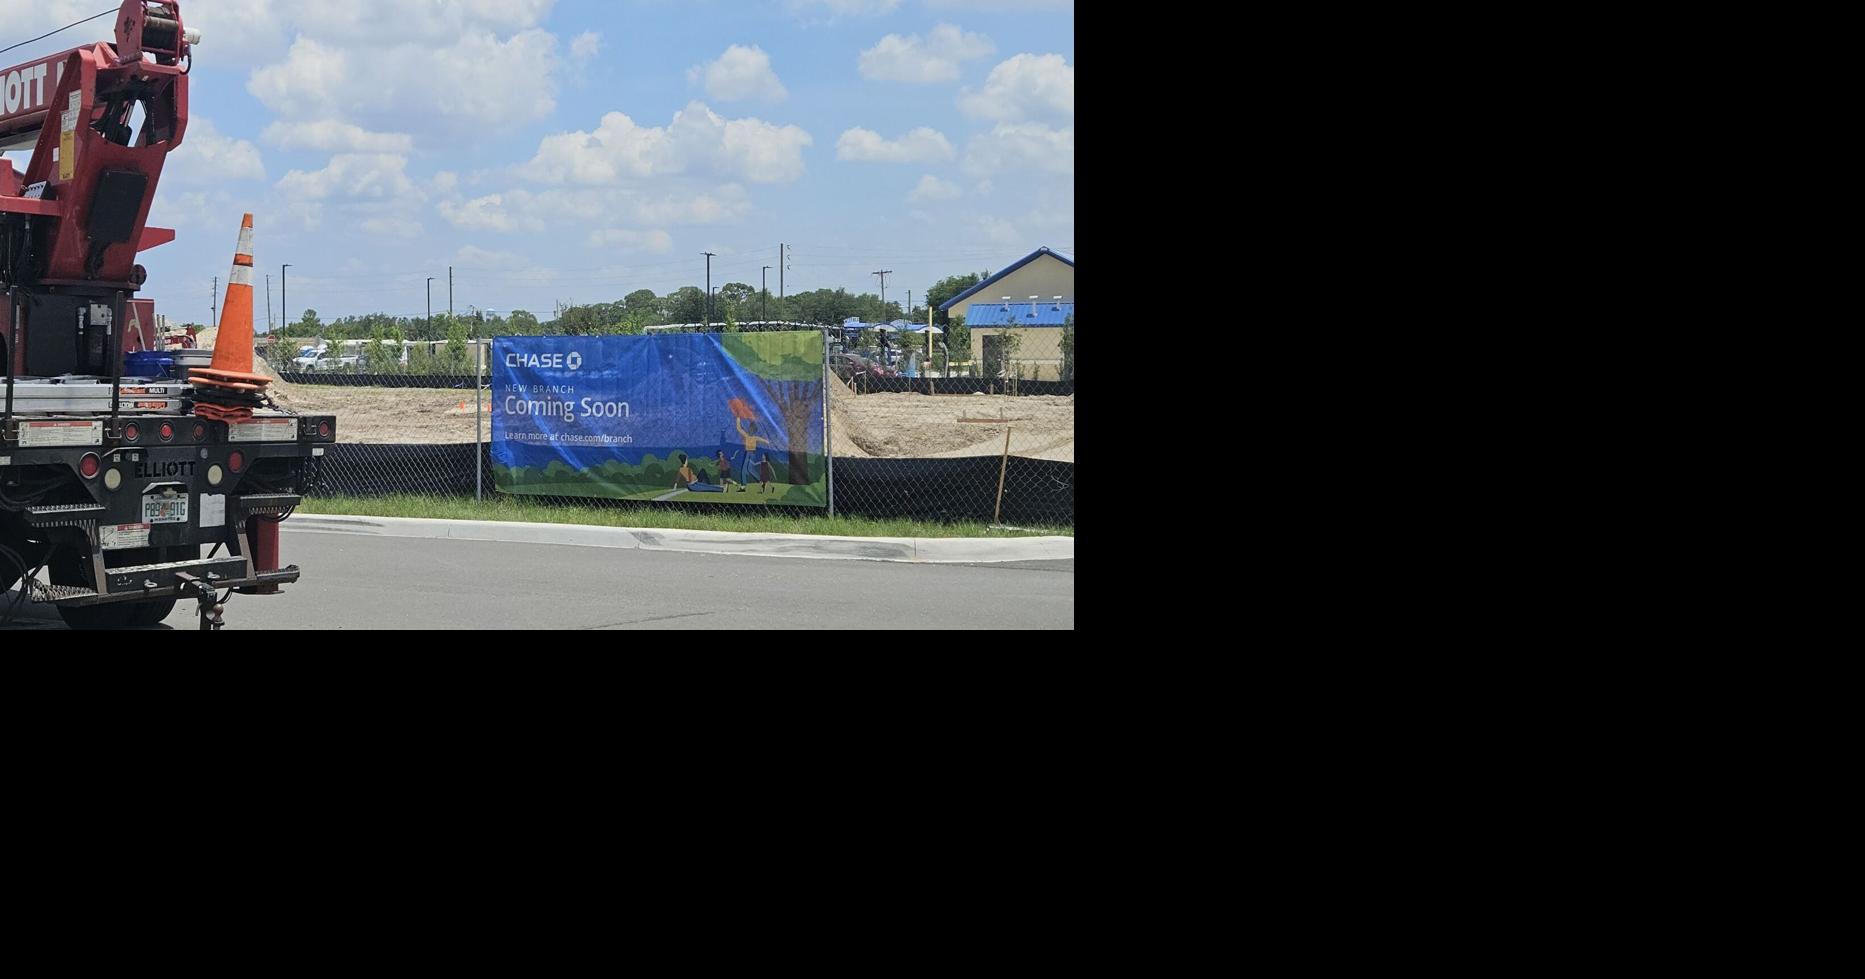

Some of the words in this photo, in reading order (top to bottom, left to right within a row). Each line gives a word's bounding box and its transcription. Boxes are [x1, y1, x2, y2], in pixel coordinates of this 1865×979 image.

[505, 352, 563, 368] CHASE
[505, 384, 528, 393] NEW
[532, 384, 575, 394] BRANCH
[504, 395, 575, 422] Coming
[581, 396, 630, 418] Soon
[504, 431, 527, 441] Learn
[528, 433, 548, 441] more
[550, 433, 559, 441] at
[560, 432, 633, 443] chase.com/branch
[135, 461, 196, 478] ELLIOTT
